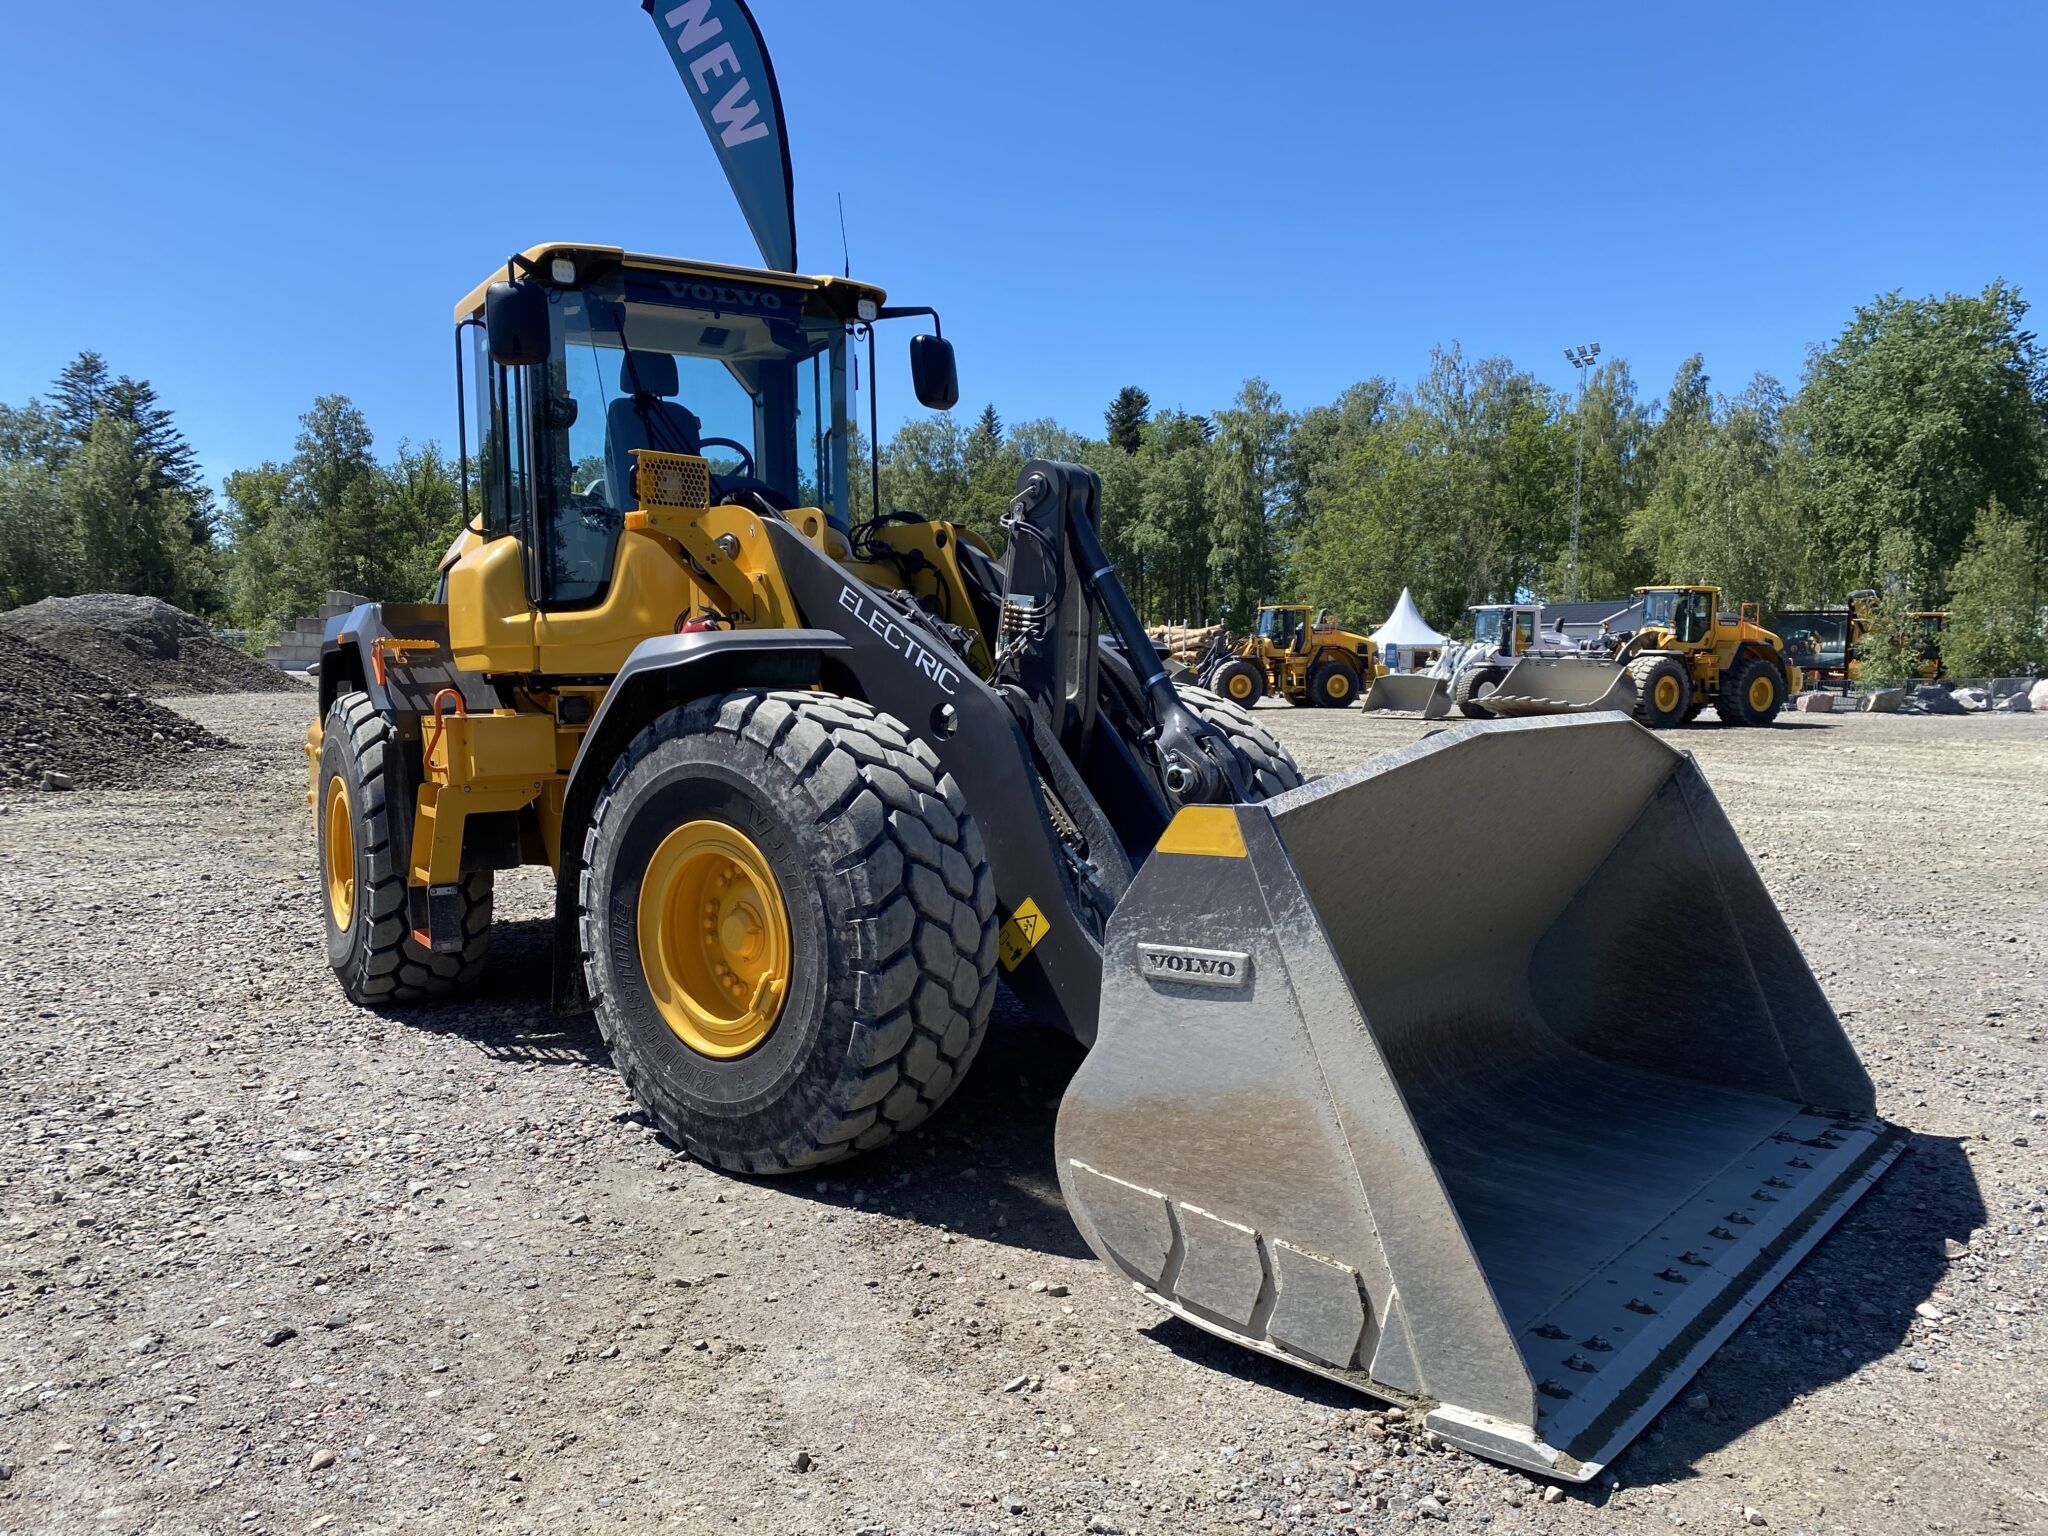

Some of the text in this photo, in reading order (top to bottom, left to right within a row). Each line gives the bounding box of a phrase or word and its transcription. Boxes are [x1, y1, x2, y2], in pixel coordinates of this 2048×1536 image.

[665, 0, 769, 148] NEW
[660, 281, 781, 309] VOLVO
[838, 585, 960, 695] ELECTRIC
[1147, 954, 1236, 977] VOLVO
